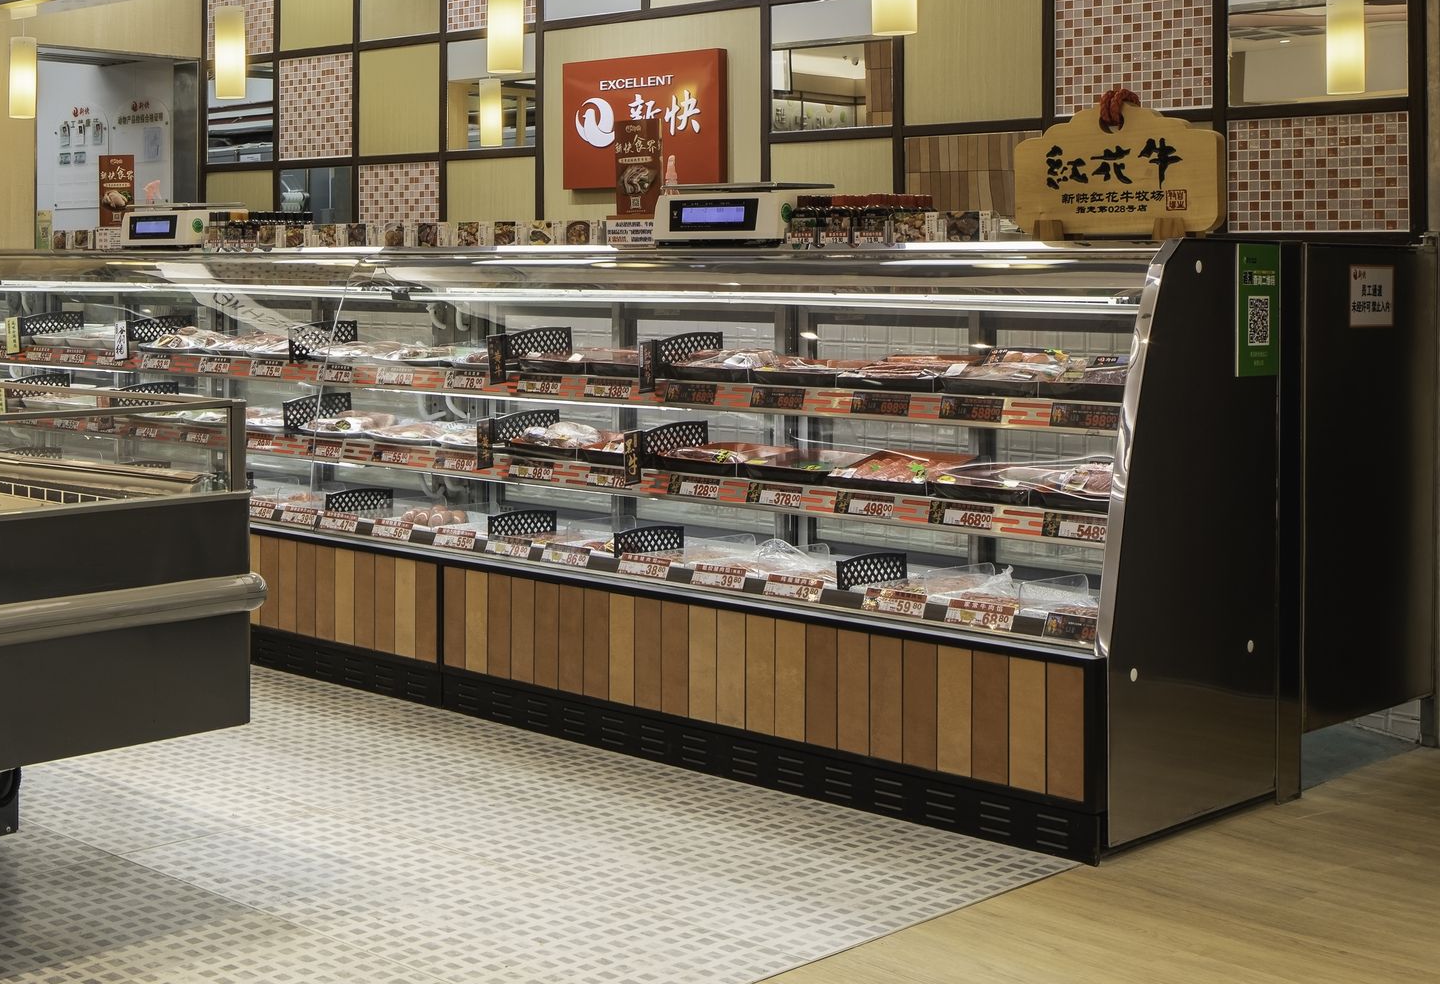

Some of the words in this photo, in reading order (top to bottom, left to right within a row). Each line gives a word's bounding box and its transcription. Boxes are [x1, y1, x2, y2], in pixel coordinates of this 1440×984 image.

[599, 74, 674, 91] EXCELLENT
[627, 89, 702, 136] 新快
[1061, 190, 1165, 205] 新快红花牛牧场
[1076, 203, 1147, 214] 指定第028号店
[531, 468, 550, 479] 98.00
[693, 484, 718, 497] 128.00
[773, 493, 801, 506] 378.00
[863, 501, 893, 517] 498.00
[959, 512, 992, 527] 468.00
[645, 564, 666, 577] 38.80
[720, 574, 742, 588] 39.80
[795, 585, 819, 599] 43.80
[896, 599, 922, 614] 59.80
[981, 612, 1009, 628] 68.80
